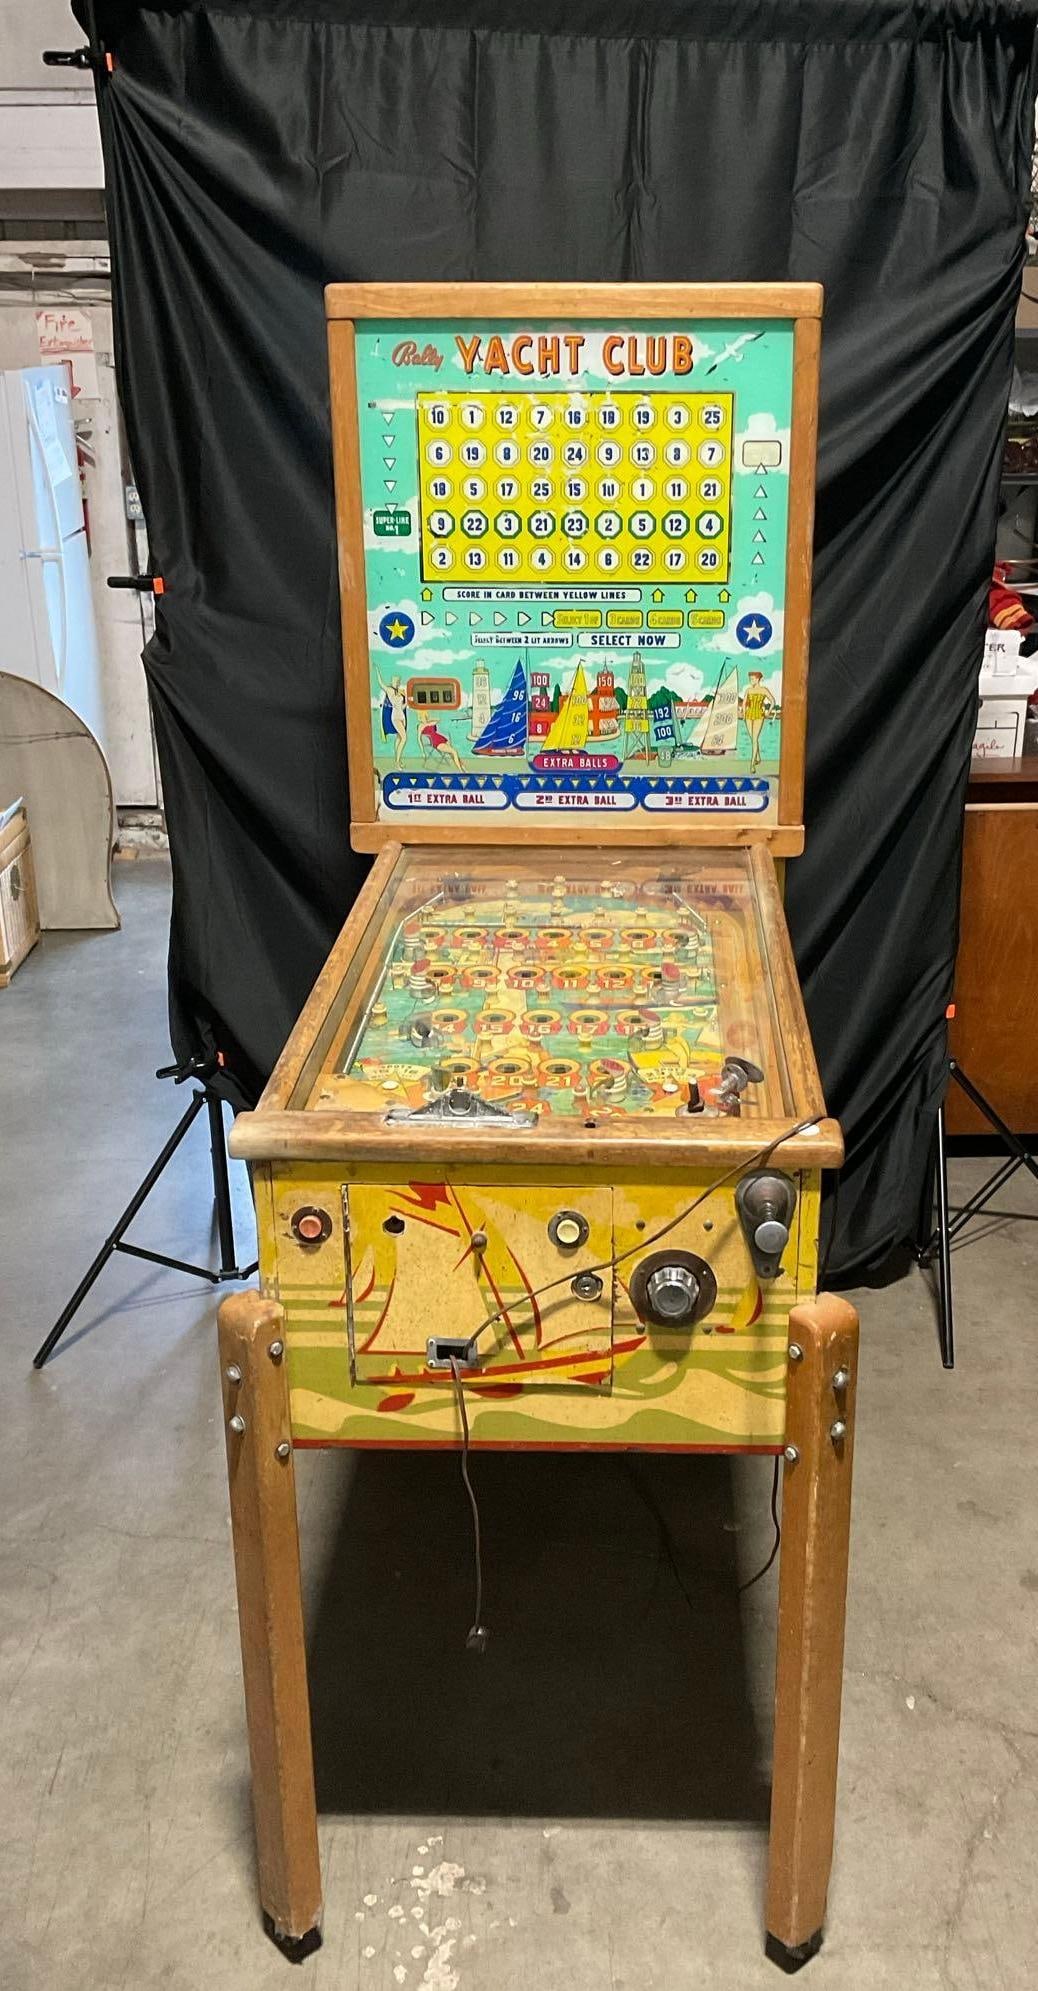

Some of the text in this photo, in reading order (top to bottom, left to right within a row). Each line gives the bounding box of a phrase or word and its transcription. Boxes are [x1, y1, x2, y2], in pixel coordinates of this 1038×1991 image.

[392, 340, 443, 372] Bally
[455, 335, 693, 376] YACHT CLUB
[431, 409, 720, 425] 10 1 12 7 16 18 19 3 25
[435, 446, 443, 461] 6
[466, 446, 479, 461] 19
[503, 446, 511, 461] 8
[534, 446, 549, 461] 20
[567, 447, 583, 461] 24
[605, 447, 613, 461] 9
[707, 447, 716, 460] 7
[434, 482, 446, 496] 18
[470, 482, 478, 496] 5
[501, 482, 514, 495] 17
[534, 483, 549, 497] 25
[569, 483, 581, 497] 15
[639, 483, 645, 496] 1
[671, 484, 681, 496] 11
[705, 483, 717, 496] 21
[437, 517, 714, 532] 9 22 3 21 23 2 5 12 4
[438, 552, 717, 567] 2 13 11 4 14 6 22 17 20
[456, 590, 627, 600] SCORE IN CARD BETWEEN YELLOW LINES
[524, 635, 530, 645] 2
[531, 636, 541, 645] LIT
[590, 635, 667, 647] SELECT NOW
[532, 674, 548, 687] 100
[598, 675, 613, 688] 150
[512, 689, 525, 701] 96
[535, 697, 546, 709] 24
[511, 712, 522, 724] 16
[654, 706, 671, 720] 192
[536, 722, 543, 734] 8
[656, 726, 672, 739] 100
[507, 732, 516, 745] 6
[543, 757, 609, 769] EXTRA BALLS
[426, 794, 456, 805] EXTRA
[461, 795, 485, 806] BALL
[557, 795, 586, 806] EXTRA
[593, 795, 618, 807] BALL
[687, 796, 716, 807] EXTRA
[723, 796, 748, 808] BALL
[513, 979, 535, 988] 10
[564, 979, 578, 988] 11
[603, 979, 625, 989] 12
[480, 1023, 504, 1033] 15
[528, 1024, 551, 1034] 16
[575, 1024, 599, 1034] 17
[491, 1075, 523, 1086] 20
[546, 1076, 572, 1087] 21
[512, 1102, 544, 1115] 24
